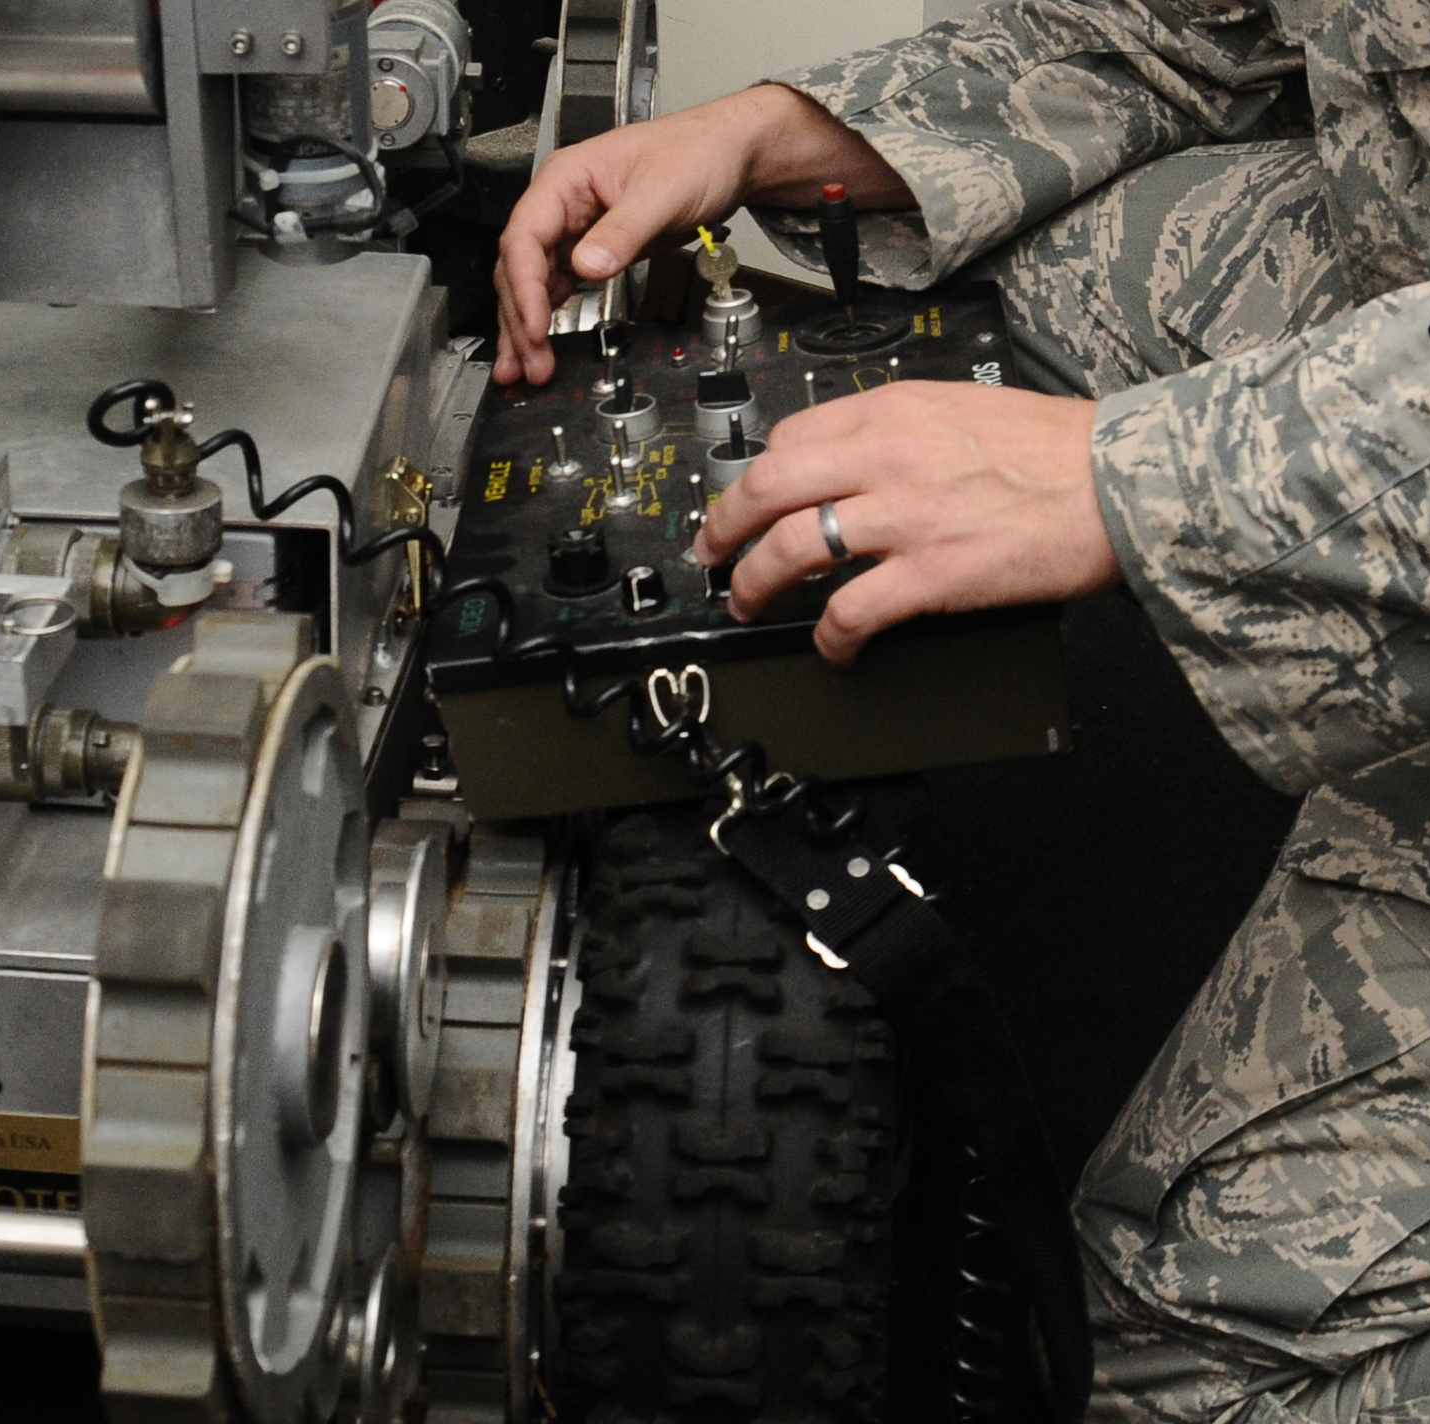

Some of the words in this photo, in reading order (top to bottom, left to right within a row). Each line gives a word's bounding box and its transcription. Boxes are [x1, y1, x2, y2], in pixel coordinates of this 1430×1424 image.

[971, 361, 1003, 386] ROS
[485, 460, 511, 502] VEHICLE
[459, 597, 486, 638] VIDEO
[11, 1133, 52, 1151] USA
